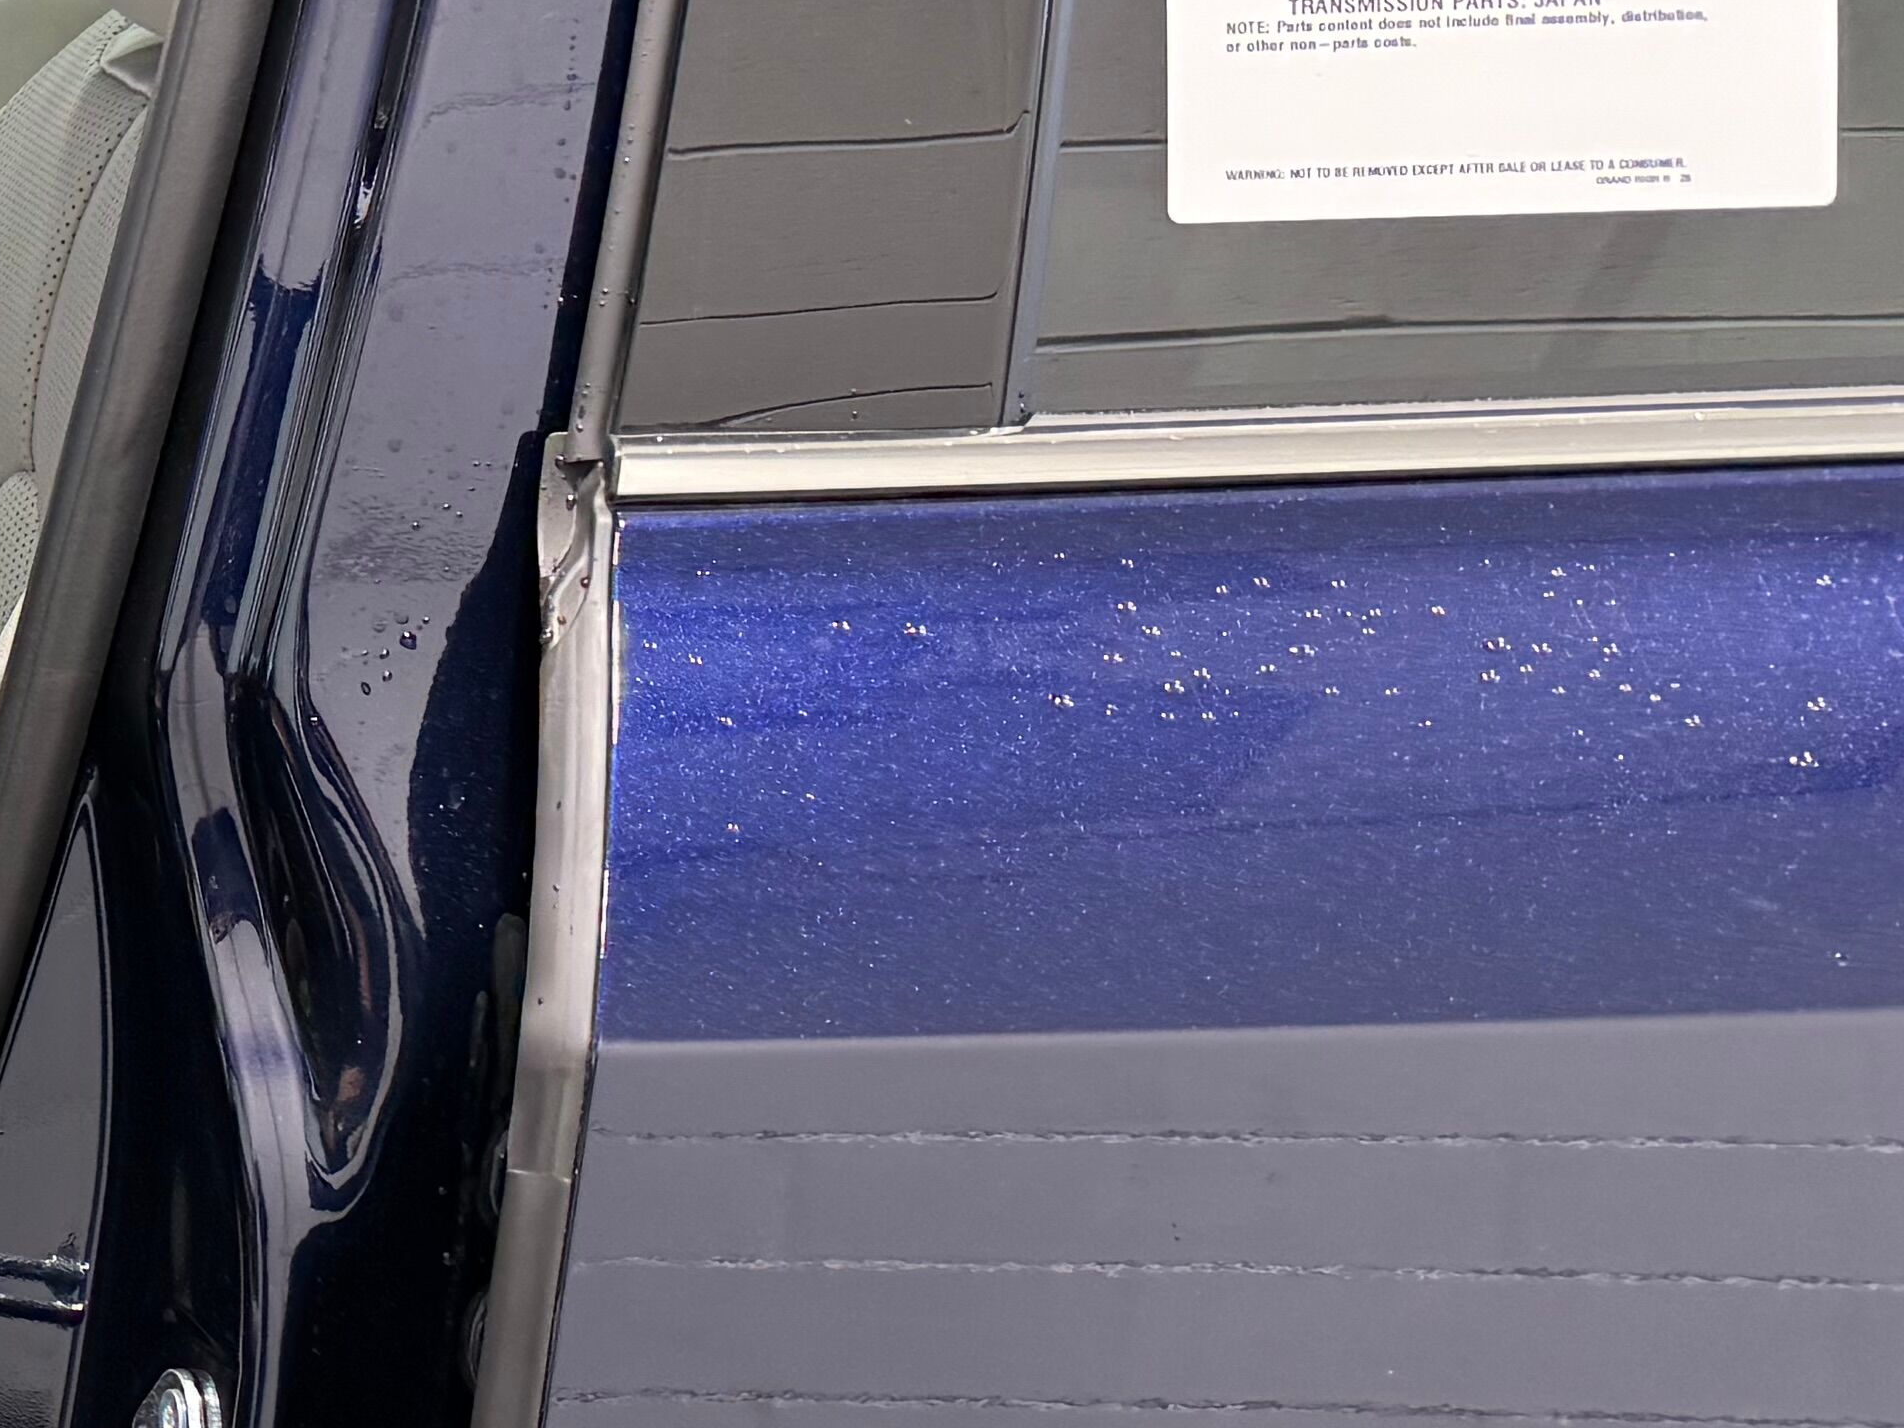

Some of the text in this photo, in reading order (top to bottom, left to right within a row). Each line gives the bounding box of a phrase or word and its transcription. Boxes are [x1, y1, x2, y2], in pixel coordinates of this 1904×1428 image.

[1226, 20, 1270, 35] NOTE:
[1277, 20, 1313, 33] Parts
[1318, 19, 1374, 32] content
[1378, 17, 1412, 30] does
[1418, 16, 1441, 29] not
[1226, 42, 1241, 53] or
[1247, 39, 1285, 52] other
[1290, 168, 1312, 179] NOT
[1316, 167, 1331, 179] TO
[1334, 166, 1348, 178] BE
[1352, 165, 1409, 177] REMOVED
[1412, 164, 1454, 176] EXCEPT
[1459, 162, 1494, 174] AFTER
[1530, 161, 1546, 172] OR
[1551, 160, 1585, 172] LEASE
[1590, 159, 1604, 171] TO
[1608, 159, 1615, 170] A
